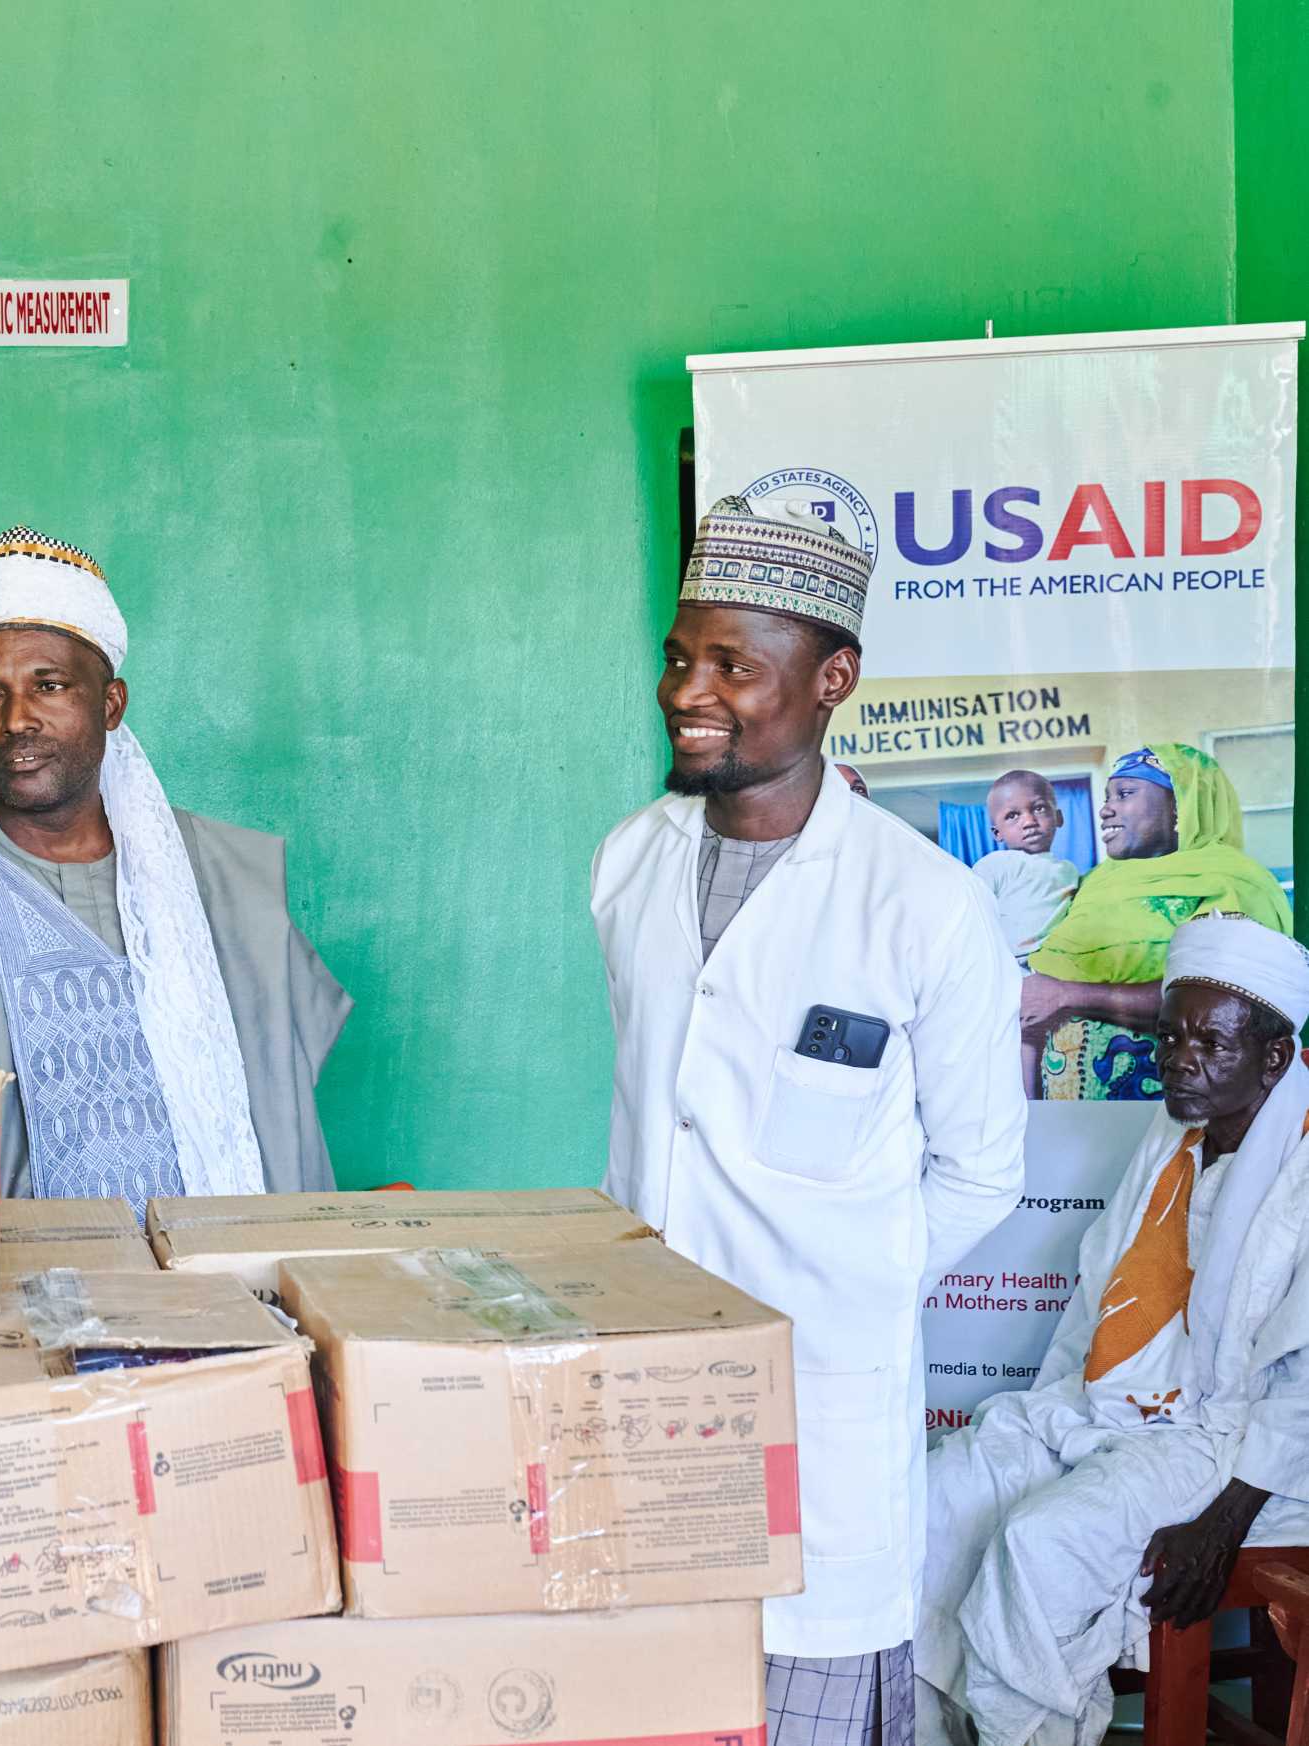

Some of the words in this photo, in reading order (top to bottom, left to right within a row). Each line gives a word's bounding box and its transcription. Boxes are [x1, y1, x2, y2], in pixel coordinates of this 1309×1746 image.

[16, 291, 111, 335] MEASUREMENT
[771, 471, 823, 486] STATES
[822, 476, 870, 518] AGENCY
[893, 478, 1263, 567] USAID
[894, 577, 966, 602] FROM
[973, 576, 1022, 599] THE
[1029, 571, 1165, 597] AMERICAN
[1172, 568, 1266, 592] PEOPLE
[860, 686, 1061, 726] IMMUNISATION
[830, 722, 985, 757] INJECTION
[998, 713, 1091, 744] ROOM
[1002, 1272, 1067, 1290] Health
[945, 1293, 1028, 1312] Mothers
[929, 1362, 977, 1376] media
[982, 1364, 997, 1377] to
[231, 1664, 247, 1687] K
[252, 1663, 302, 1687] nutri
